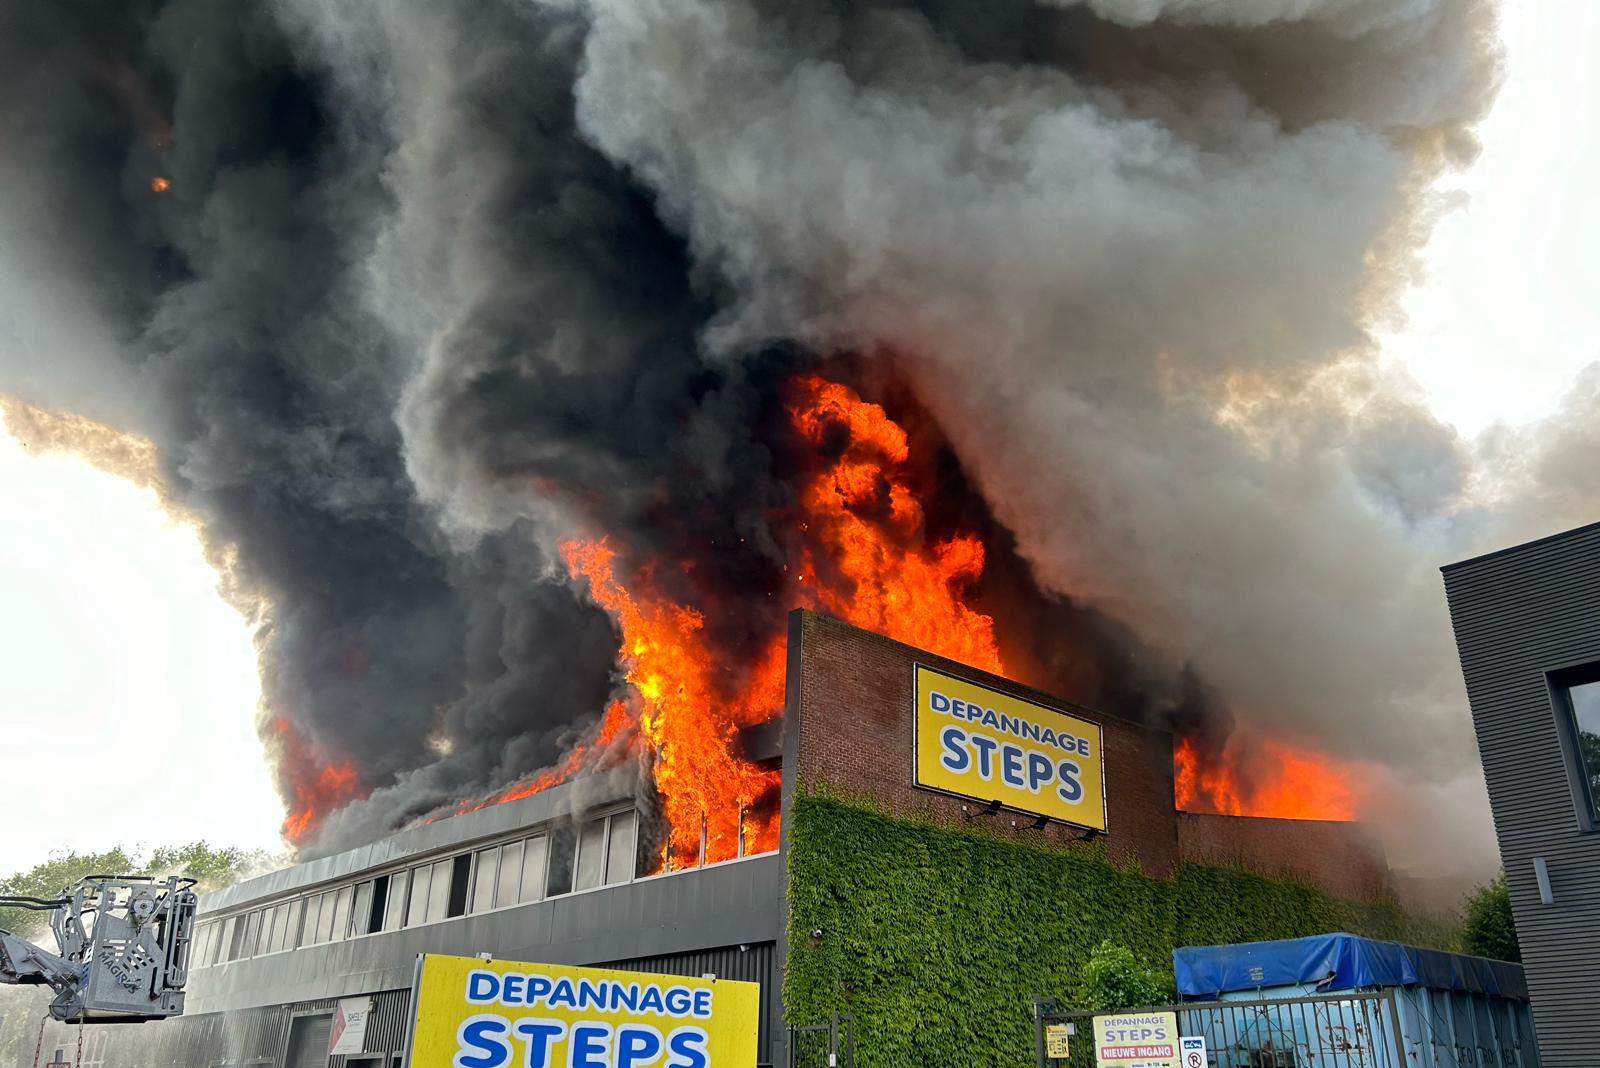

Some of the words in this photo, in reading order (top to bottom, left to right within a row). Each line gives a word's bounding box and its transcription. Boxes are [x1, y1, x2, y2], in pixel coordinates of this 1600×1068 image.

[931, 692, 1090, 756] DEPANNAGE
[942, 728, 1082, 802] STEPS
[98, 951, 140, 994] MAGIRUS
[468, 972, 711, 1016] DEPANNAGE
[1104, 1016, 1165, 1027] DEPANNAGE
[1105, 1028, 1166, 1042] STEPS
[458, 1020, 707, 1068] STEPS
[1103, 1047, 1136, 1058] NIEUWE
[1137, 1046, 1172, 1057] INGANG
